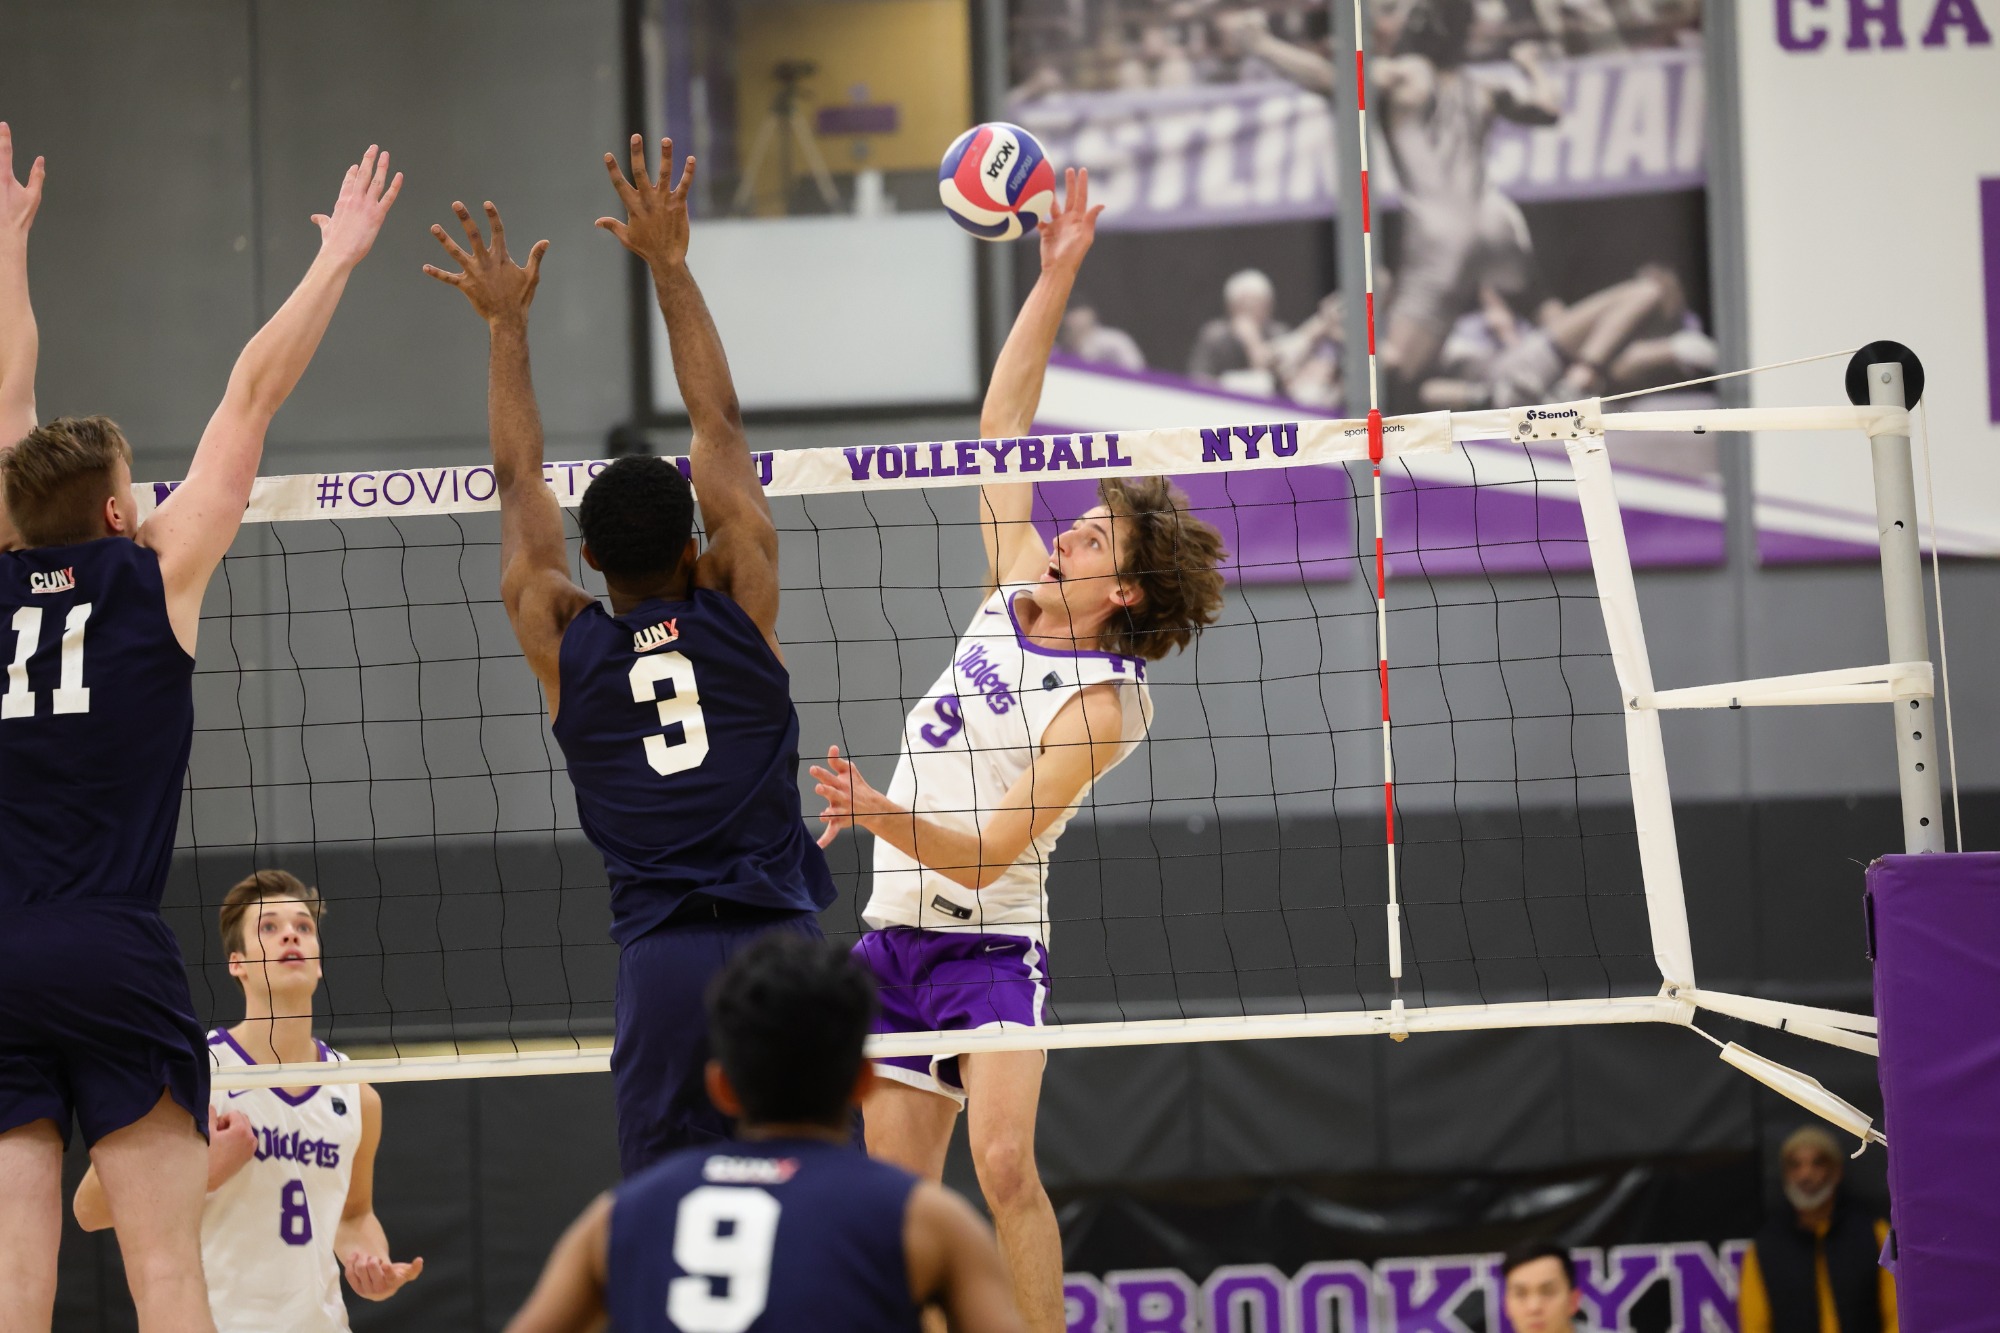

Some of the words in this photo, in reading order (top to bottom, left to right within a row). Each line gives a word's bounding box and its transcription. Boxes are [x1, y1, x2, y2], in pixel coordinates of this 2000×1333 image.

[986, 141, 1016, 179] NCAA
[1009, 154, 1034, 192] molten
[1538, 409, 1578, 420] Senoh
[843, 433, 1133, 481] VOLLEYBALL
[1200, 422, 1299, 462] NYU
[30, 566, 76, 590] CUNY
[1, 602, 93, 720] 11
[955, 642, 1017, 715] Violets
[628, 650, 710, 777] 3
[920, 693, 963, 748] 9
[279, 1179, 313, 1246] 8
[665, 1185, 783, 1333] 9
